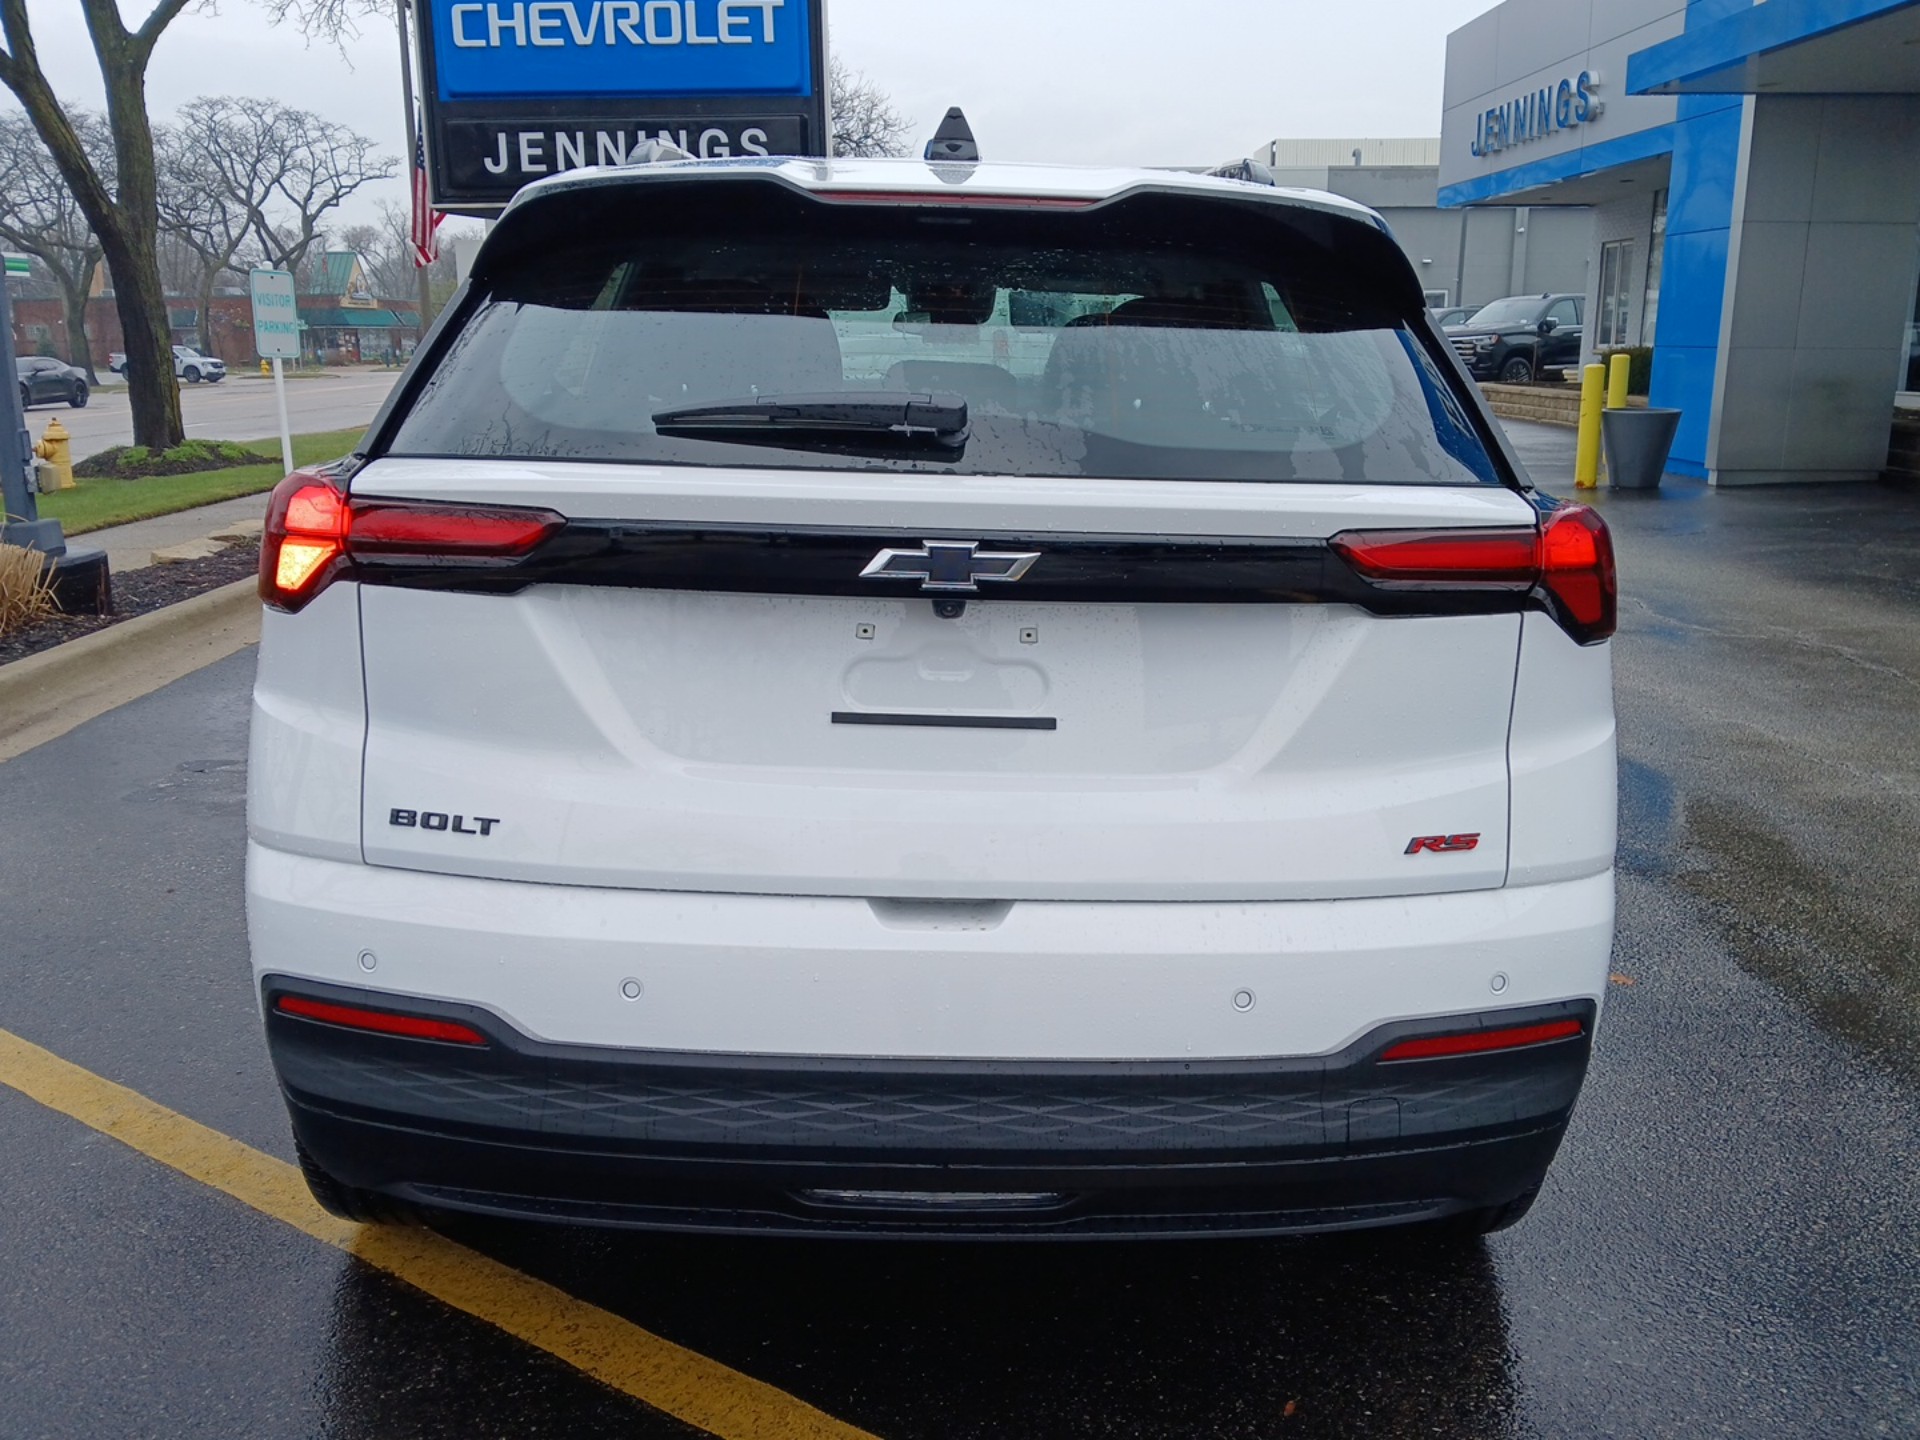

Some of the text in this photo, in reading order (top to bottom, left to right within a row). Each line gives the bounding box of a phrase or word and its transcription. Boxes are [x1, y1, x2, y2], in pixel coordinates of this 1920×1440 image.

[451, 0, 785, 48] CHEVROLET
[1471, 70, 1598, 157] JENNINGS
[484, 127, 769, 174] JENNGS
[256, 293, 292, 308] VISITOR
[257, 320, 296, 335] PARKING
[389, 808, 500, 836] BOLT
[1404, 832, 1481, 855] RS
